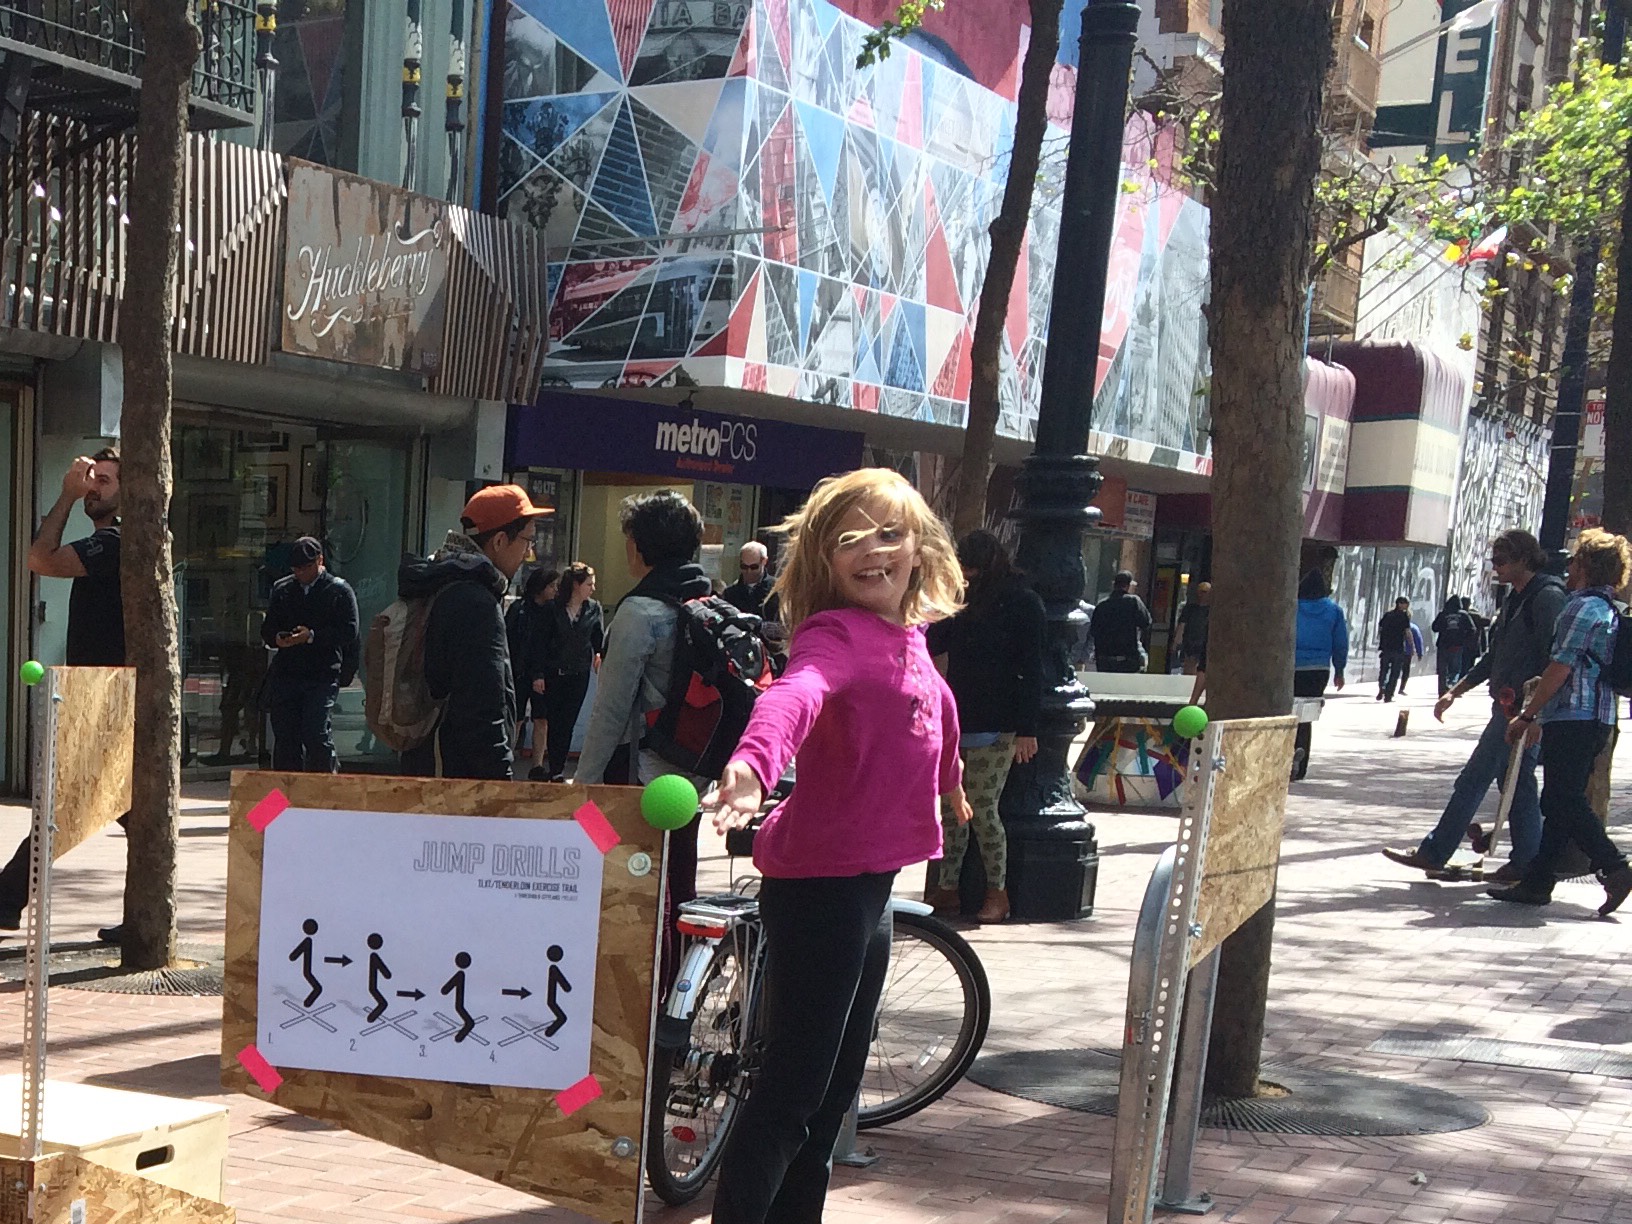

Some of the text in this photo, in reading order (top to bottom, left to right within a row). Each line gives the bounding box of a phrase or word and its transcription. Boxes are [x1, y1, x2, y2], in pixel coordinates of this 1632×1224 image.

[287, 222, 444, 322] Huckleberry
[655, 418, 759, 462] metroPCS
[413, 841, 581, 879] JUMP DRILLS
